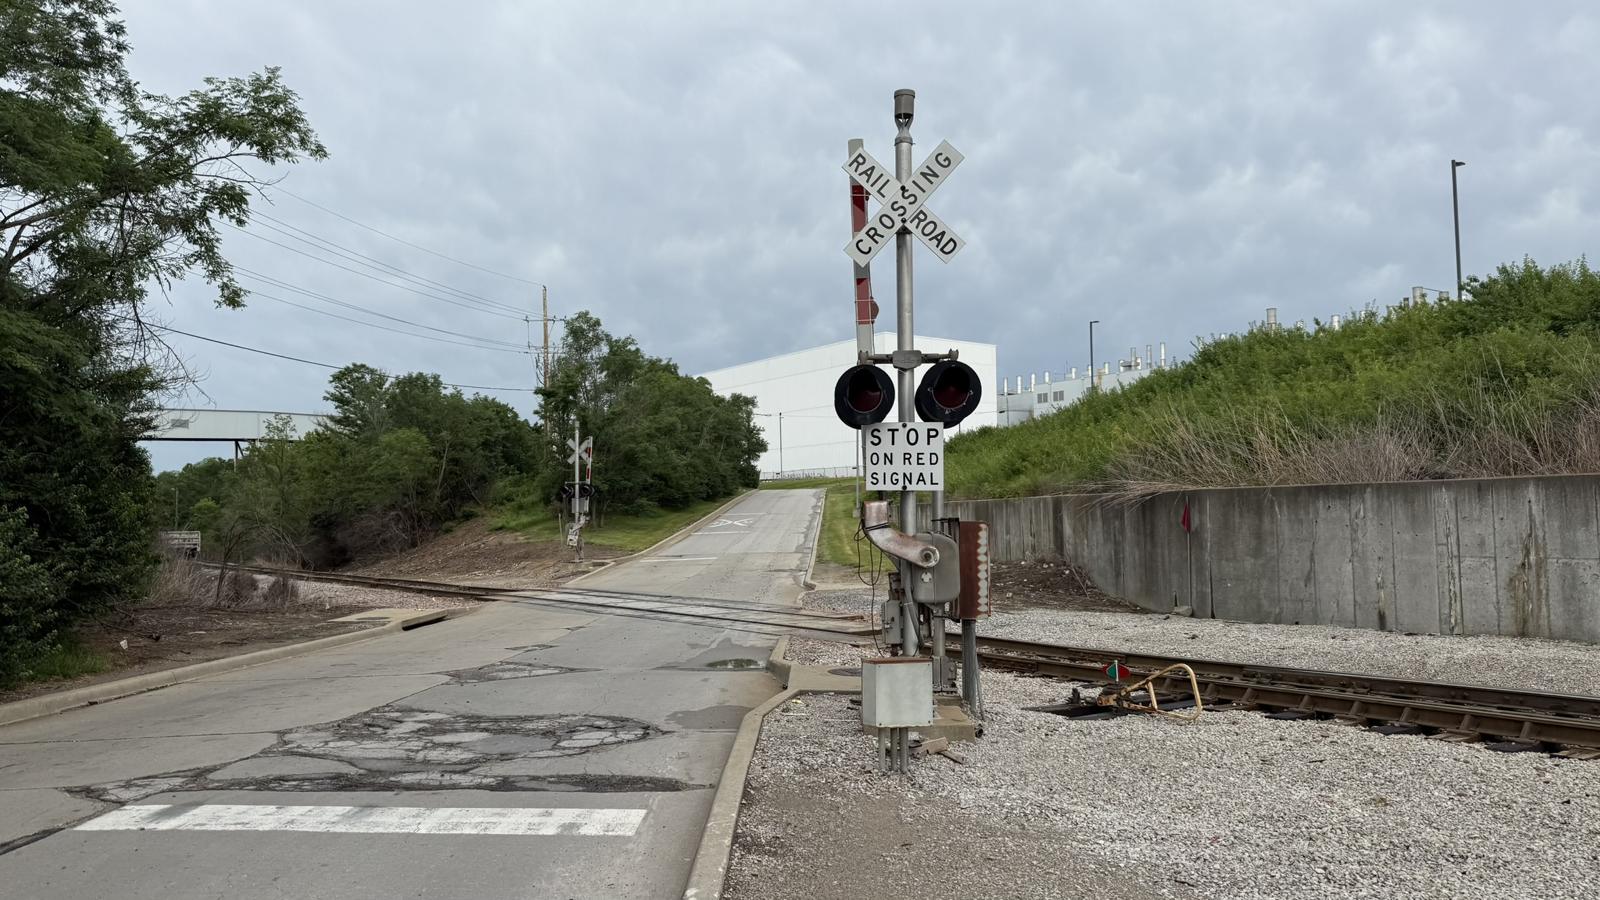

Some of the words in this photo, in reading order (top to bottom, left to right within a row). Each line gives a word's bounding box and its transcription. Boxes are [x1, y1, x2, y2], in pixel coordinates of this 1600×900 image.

[848, 153, 890, 198] RAIL
[909, 209, 958, 255] ROAD
[855, 152, 952, 255] CROSSING
[870, 428, 939, 445] STOP
[870, 453, 893, 465] ON
[902, 453, 939, 465] RED
[870, 472, 939, 485] SIGNAL
